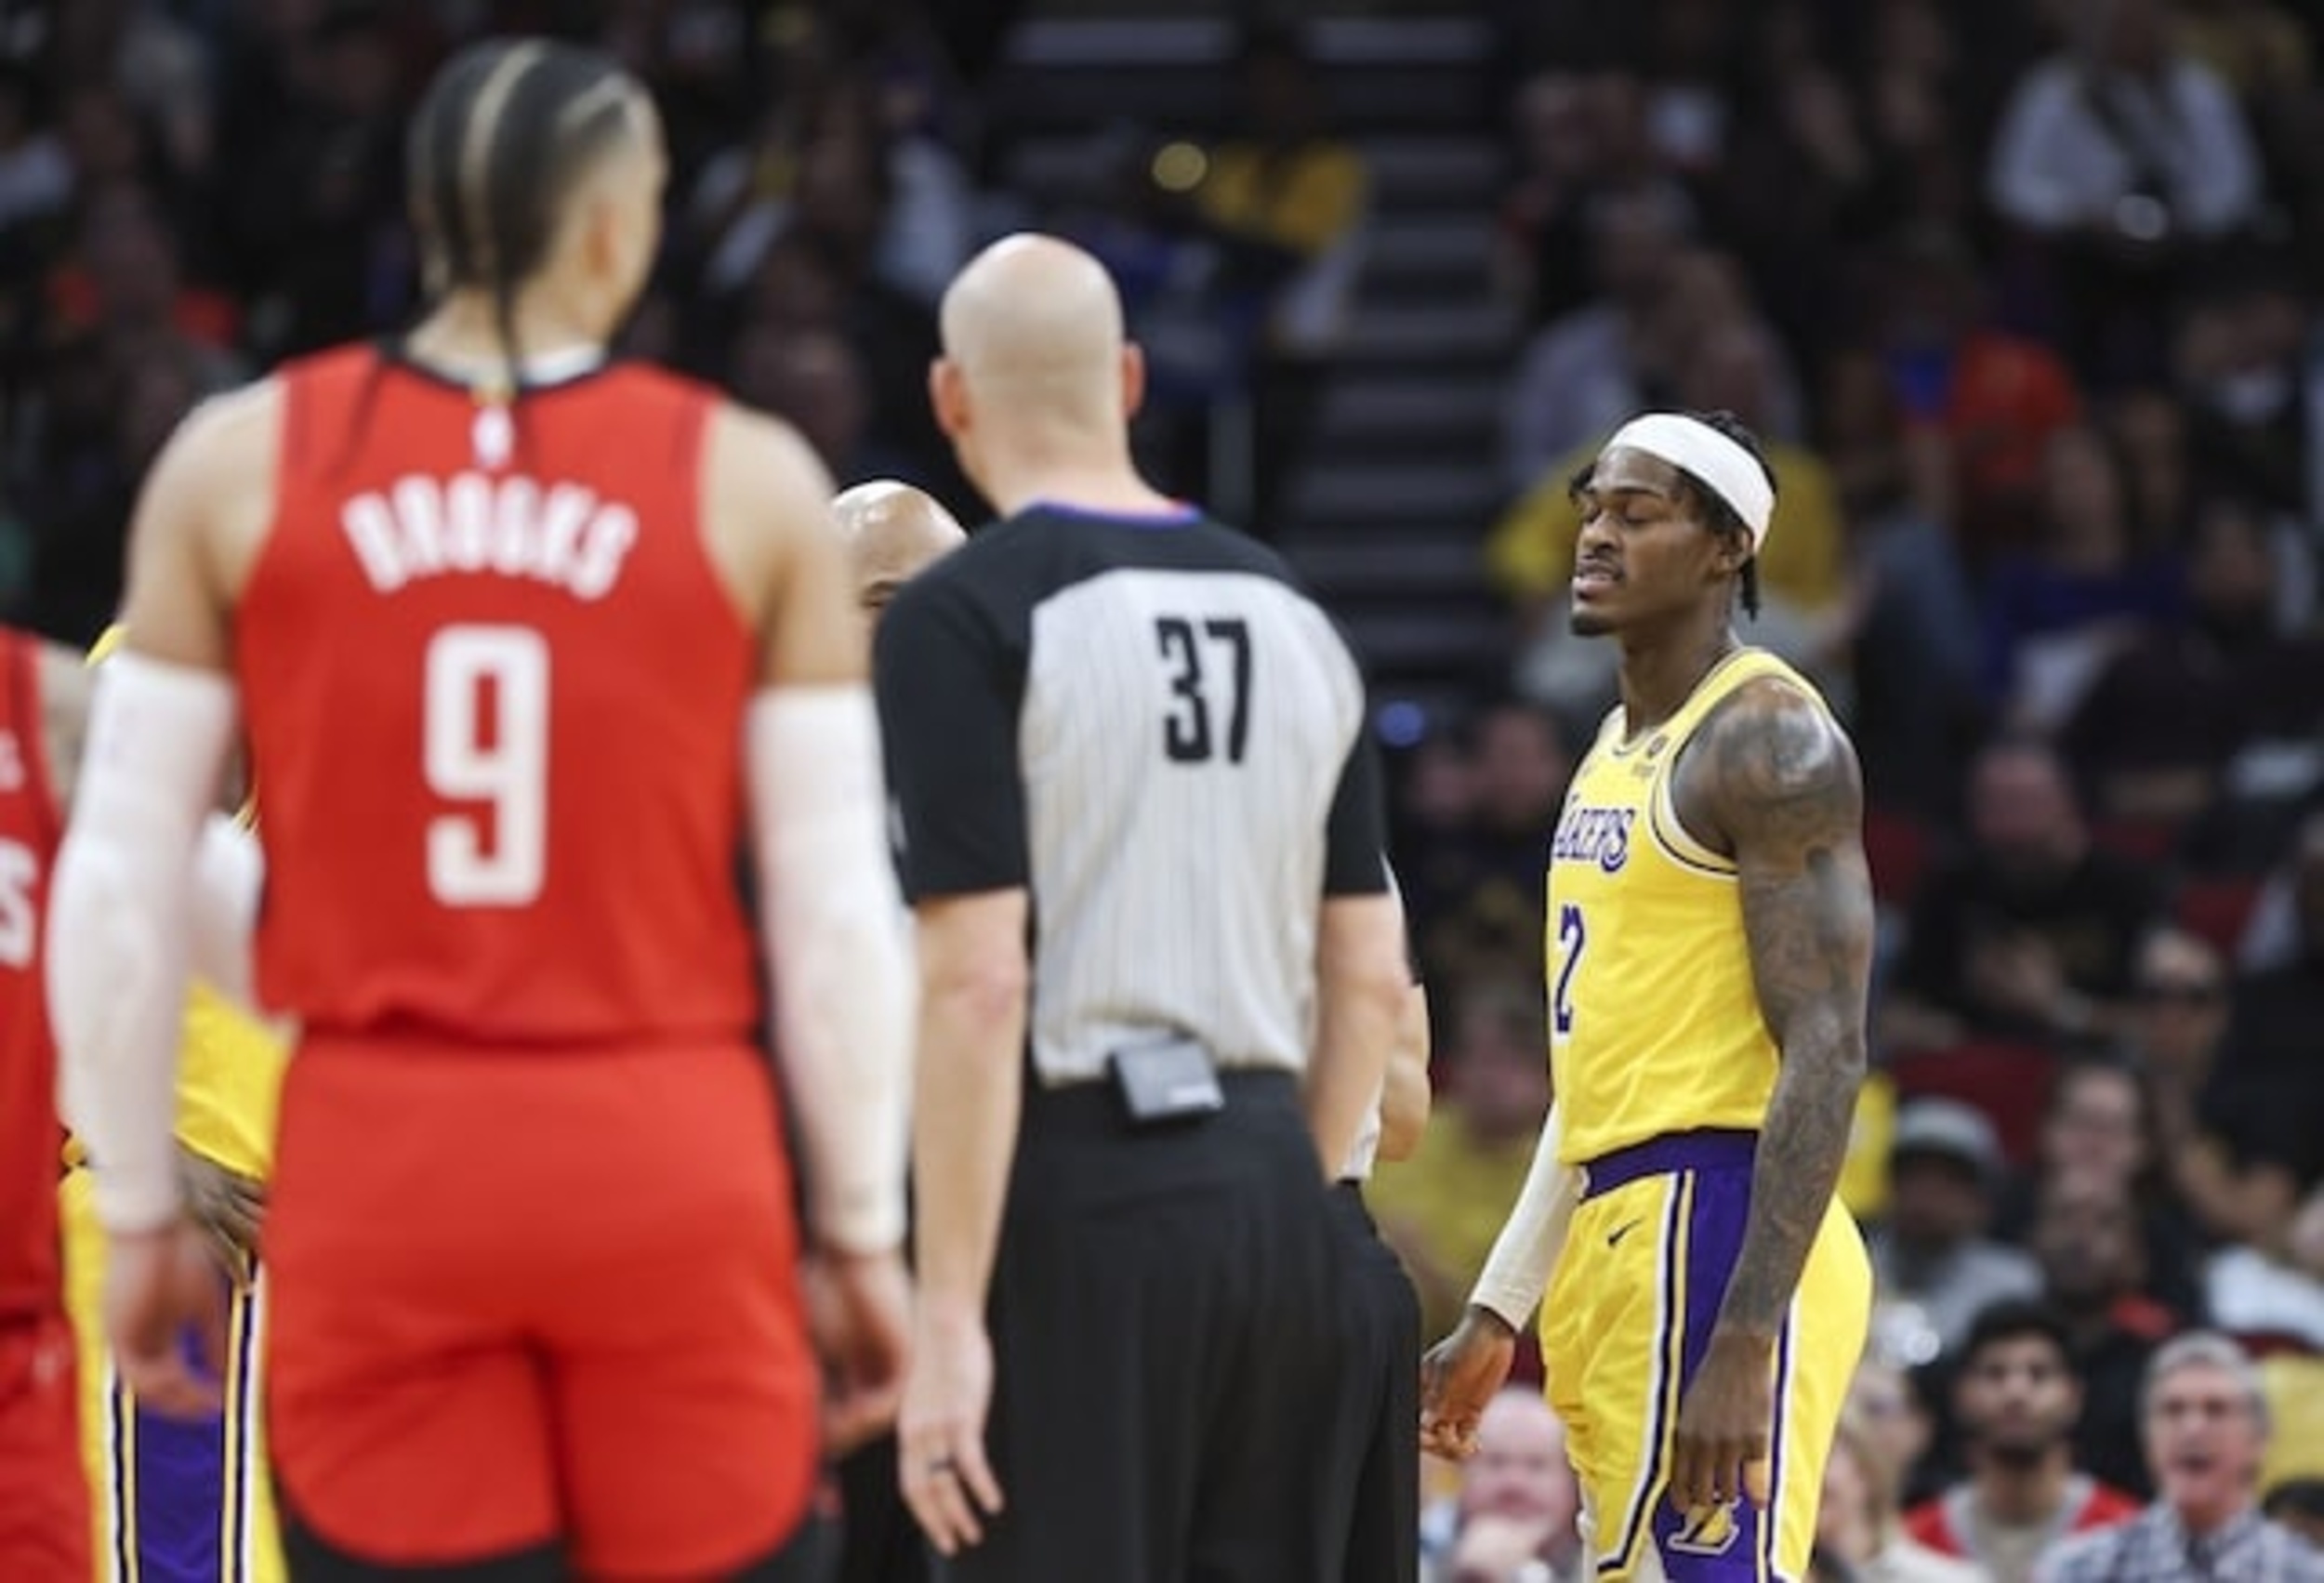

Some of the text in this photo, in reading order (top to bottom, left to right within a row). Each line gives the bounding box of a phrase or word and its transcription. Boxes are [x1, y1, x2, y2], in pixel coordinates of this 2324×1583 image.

[425, 621, 551, 908] 9
[1155, 615, 1252, 765] 37
[1555, 903, 1586, 1035] 2
